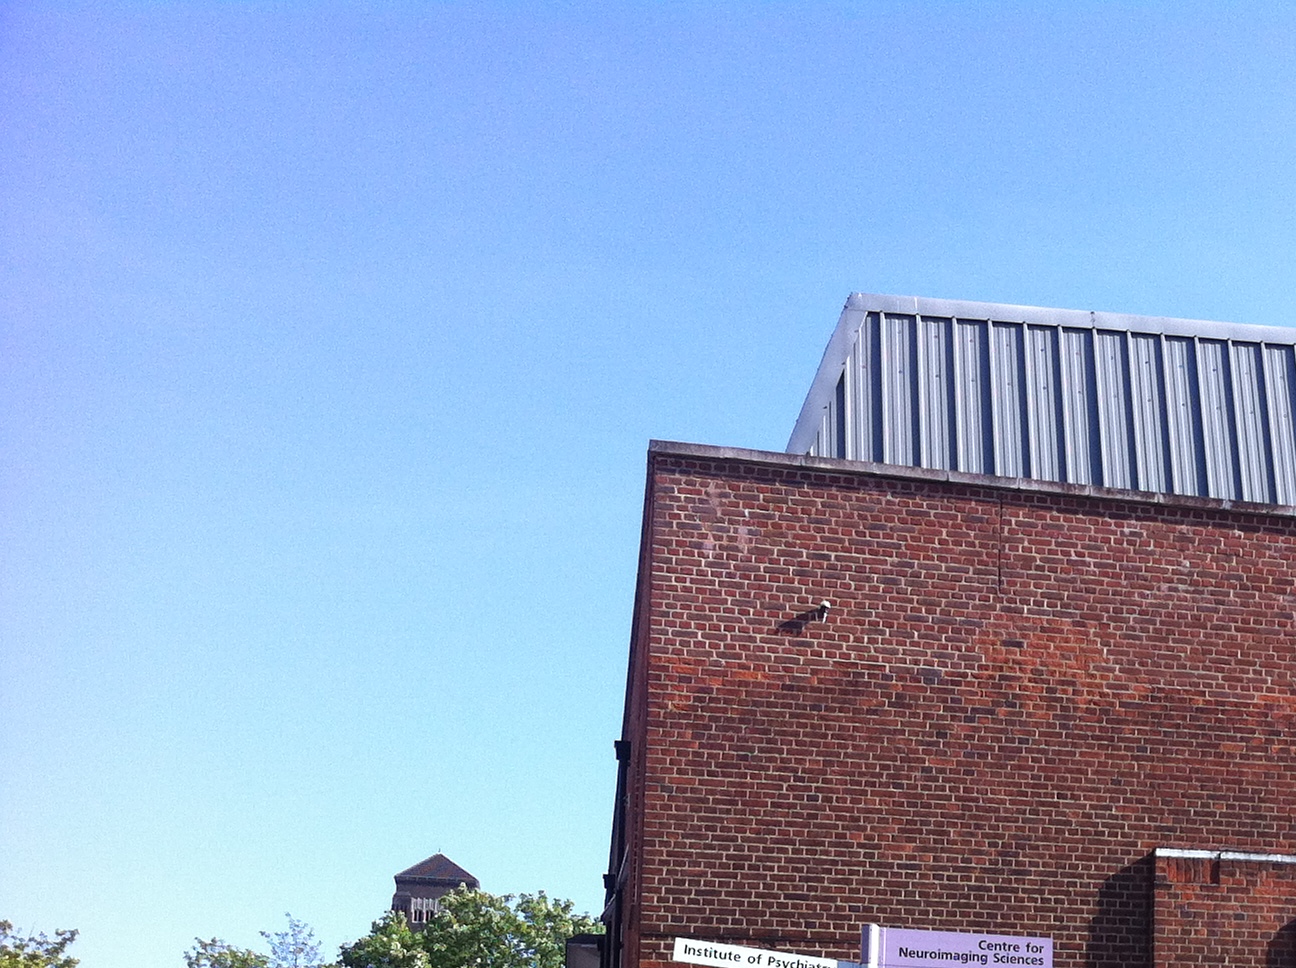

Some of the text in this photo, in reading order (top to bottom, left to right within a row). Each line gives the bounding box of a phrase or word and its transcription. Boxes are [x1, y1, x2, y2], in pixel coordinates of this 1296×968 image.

[684, 944, 741, 962] Institute
[747, 953, 763, 965] of
[899, 947, 1044, 966] Neuroimaging Sciences
[978, 940, 1044, 954] Centre for
